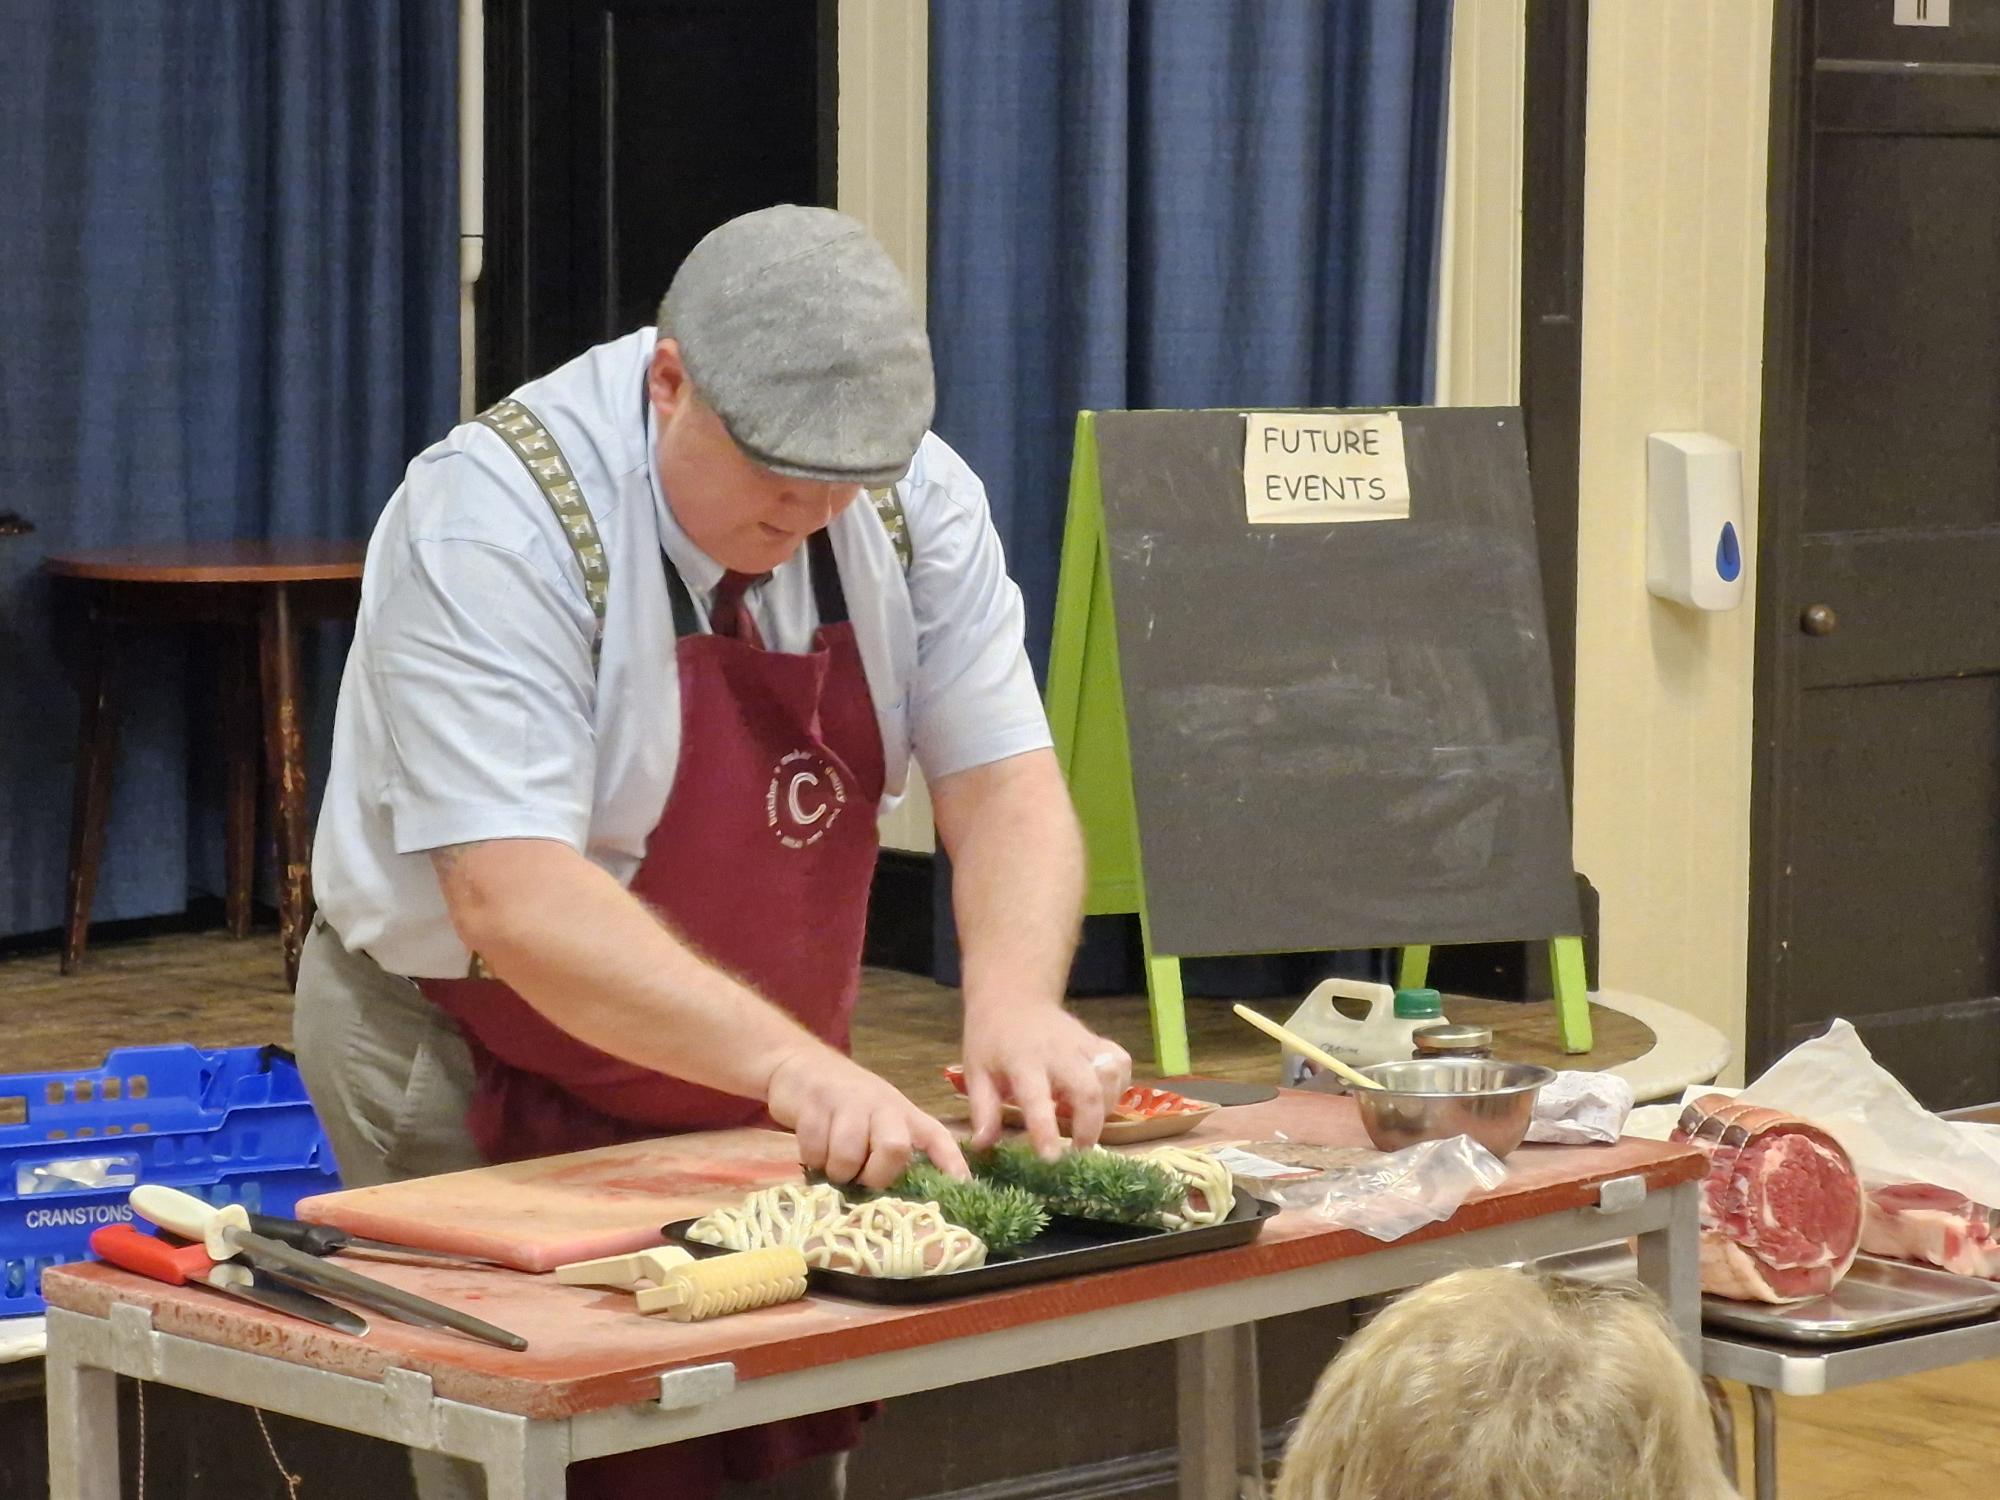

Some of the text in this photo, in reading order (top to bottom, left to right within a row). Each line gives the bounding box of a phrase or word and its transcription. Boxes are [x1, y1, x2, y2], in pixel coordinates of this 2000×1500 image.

[1264, 427, 1379, 455] FUTURE
[1266, 475, 1386, 501] EVENTS
[788, 772, 827, 825] C
[26, 1204, 134, 1228] CRANSTONS
